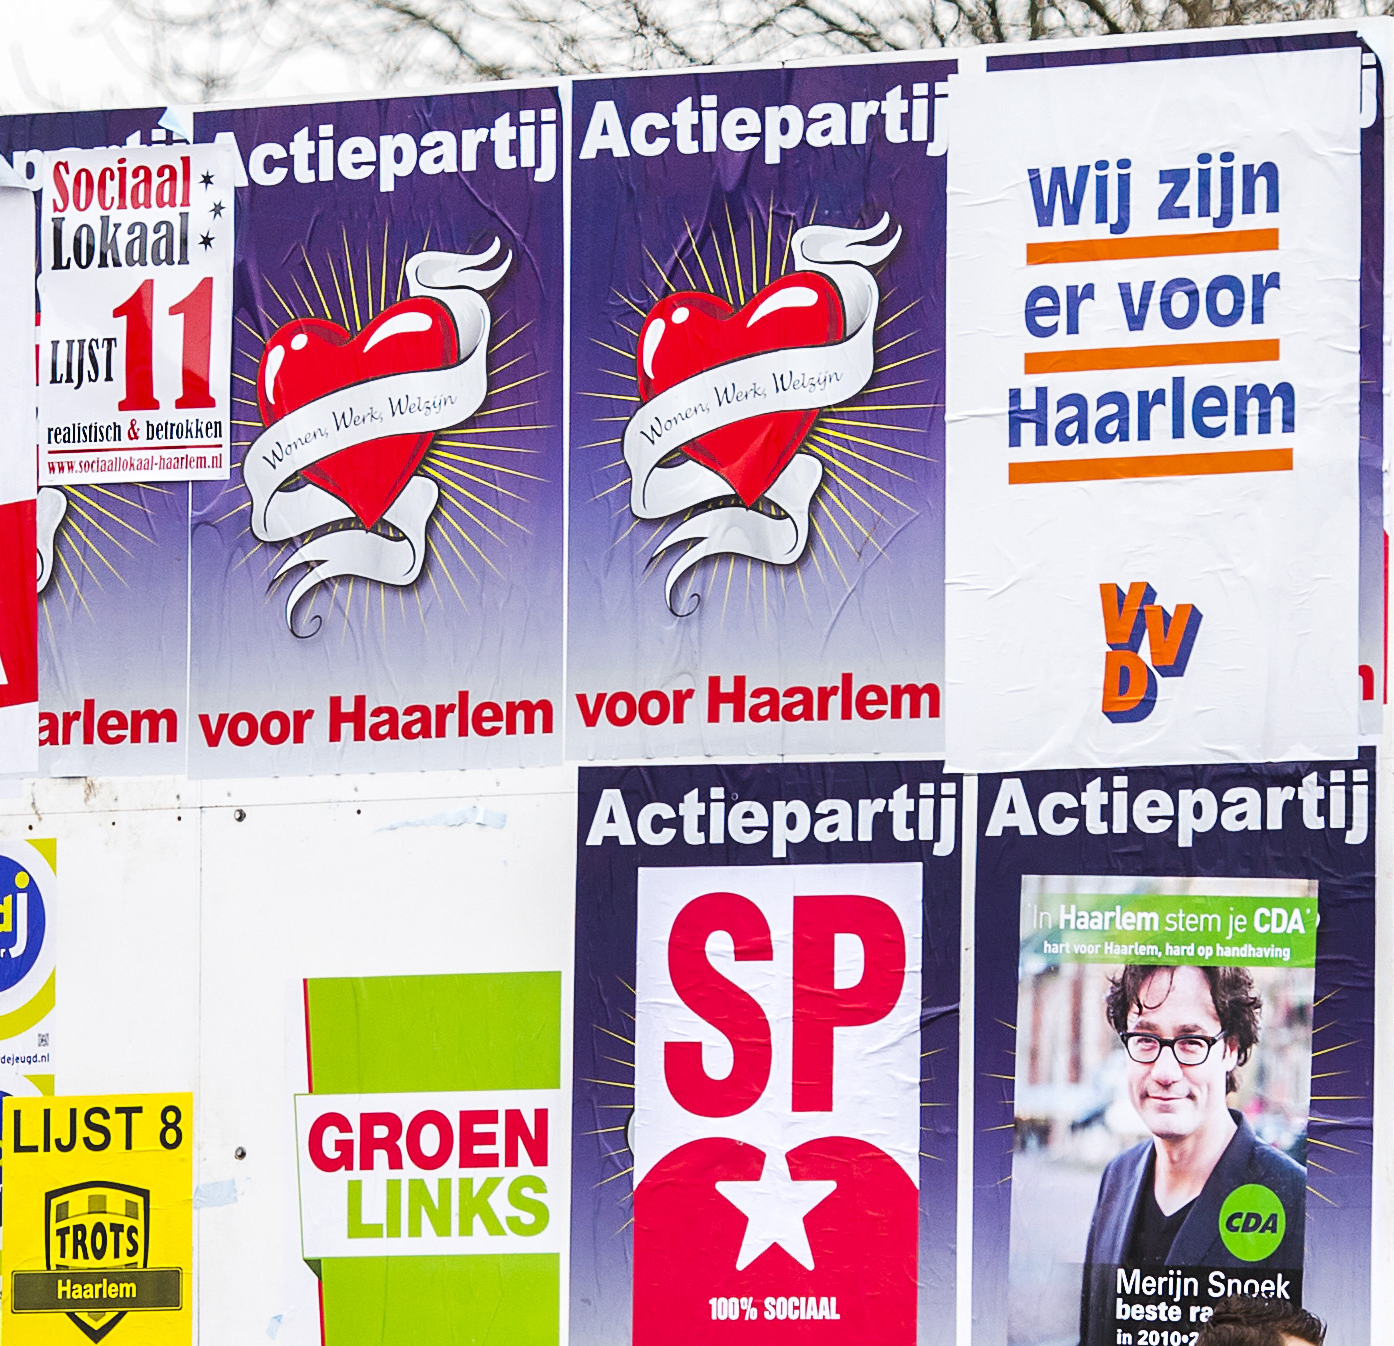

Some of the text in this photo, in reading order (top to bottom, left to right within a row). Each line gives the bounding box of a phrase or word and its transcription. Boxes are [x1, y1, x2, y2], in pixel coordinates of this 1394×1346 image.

[578, 81, 950, 166] Actiepartij
[52, 155, 192, 214] Sociaal
[1026, 150, 1281, 236] Wij zijn
[50, 211, 191, 271] Lokaal
[1023, 270, 1282, 339] er voor
[49, 275, 217, 413] LIJST 11
[46, 417, 223, 445] realistisch & betrokken
[262, 392, 459, 471] Wonen, Werk, Welzijn
[639, 369, 845, 447] Wonen, Werk, Welzijn
[1007, 375, 1296, 449] Haarlem
[46, 452, 224, 476] www.sociaallokaal-haarlem.nl
[38, 698, 178, 748] arlem
[197, 690, 555, 749] voor Haarlem
[574, 671, 942, 730] voor Haarlem
[584, 782, 957, 859] Actiepartij
[985, 769, 1371, 848] Actiepartij
[1043, 939, 1292, 962] hart voor Haarlem, hard op handhaving
[1058, 904, 1160, 933] Haarlem
[1164, 908, 1222, 933] stem
[1226, 906, 1248, 941] je
[663, 891, 907, 1119] SP
[13, 1103, 184, 1157] LIJST 8
[306, 1106, 550, 1173] GROEN
[346, 1174, 551, 1241] LINKS
[1224, 1211, 1279, 1235] CDA
[54, 1219, 141, 1262] TROTS
[55, 1277, 138, 1303] Haarlem
[708, 1296, 842, 1322] 100% SOCIAAL
[1115, 1267, 1292, 1303] Merijn Snoek
[1115, 1297, 1182, 1323] beste
[1115, 1328, 1133, 1346] in
